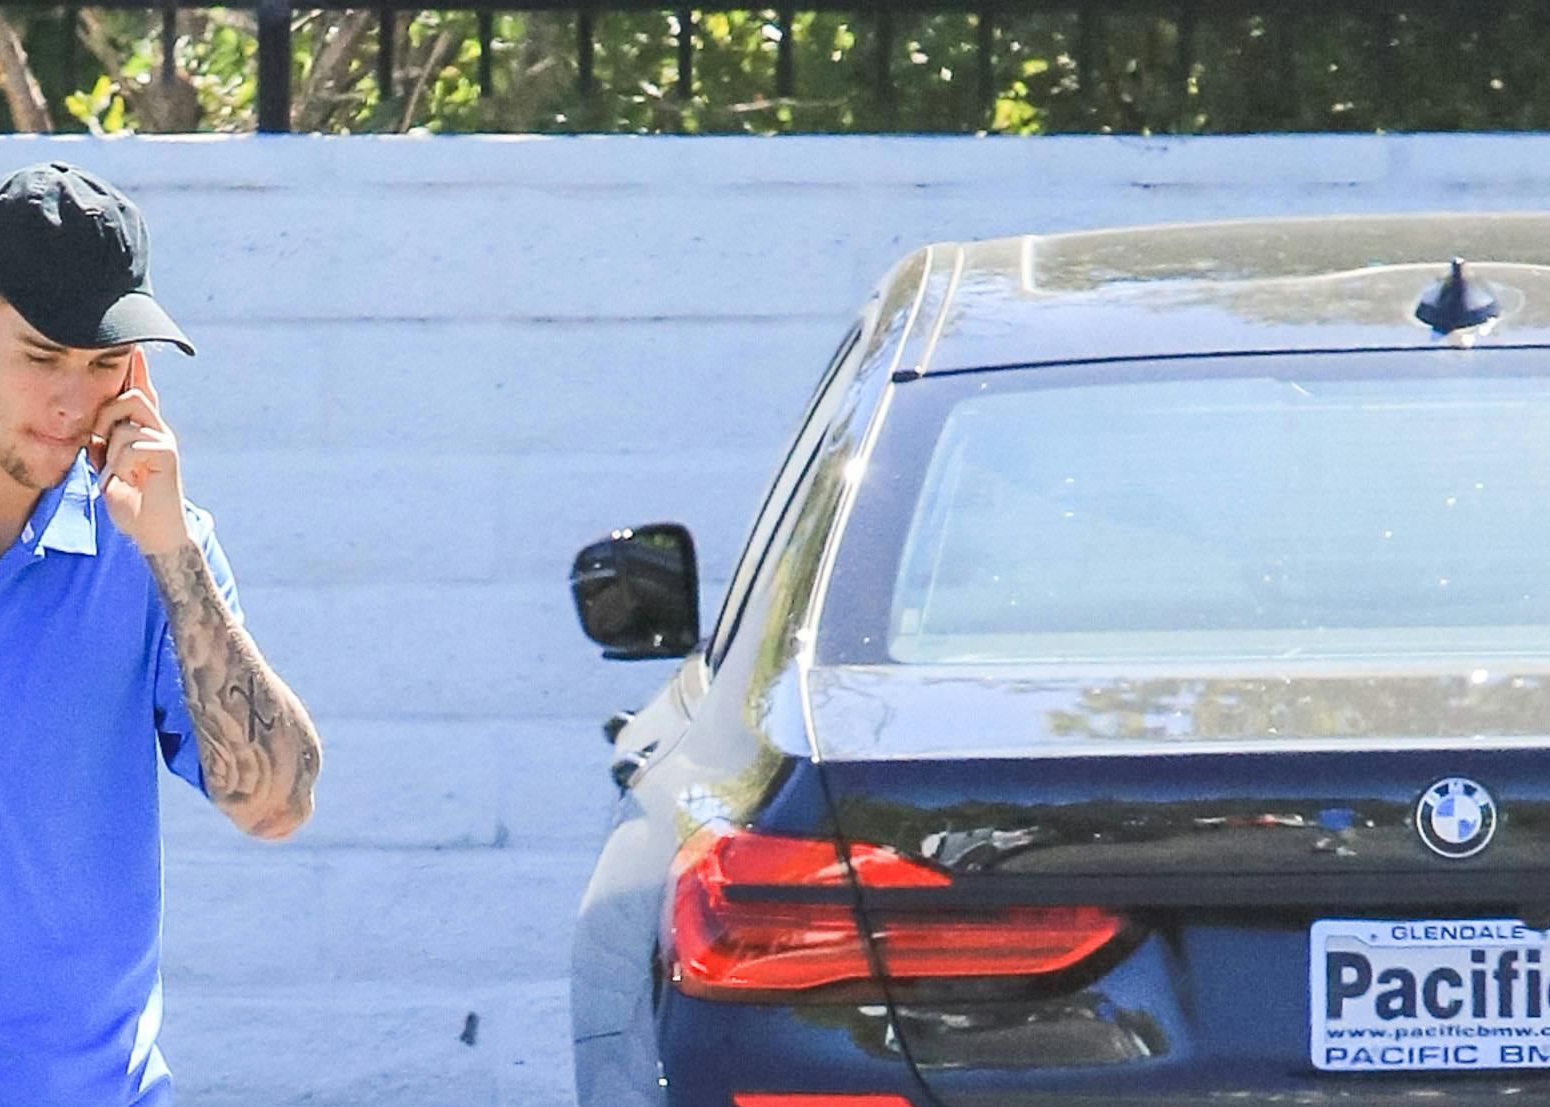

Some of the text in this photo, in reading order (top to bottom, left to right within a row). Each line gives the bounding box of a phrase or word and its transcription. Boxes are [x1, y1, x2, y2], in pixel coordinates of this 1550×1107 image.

[1392, 926, 1525, 940] GLENDALE
[1326, 949, 1550, 1020] Pacifi
[1325, 1046, 1477, 1064] PACIFIC
